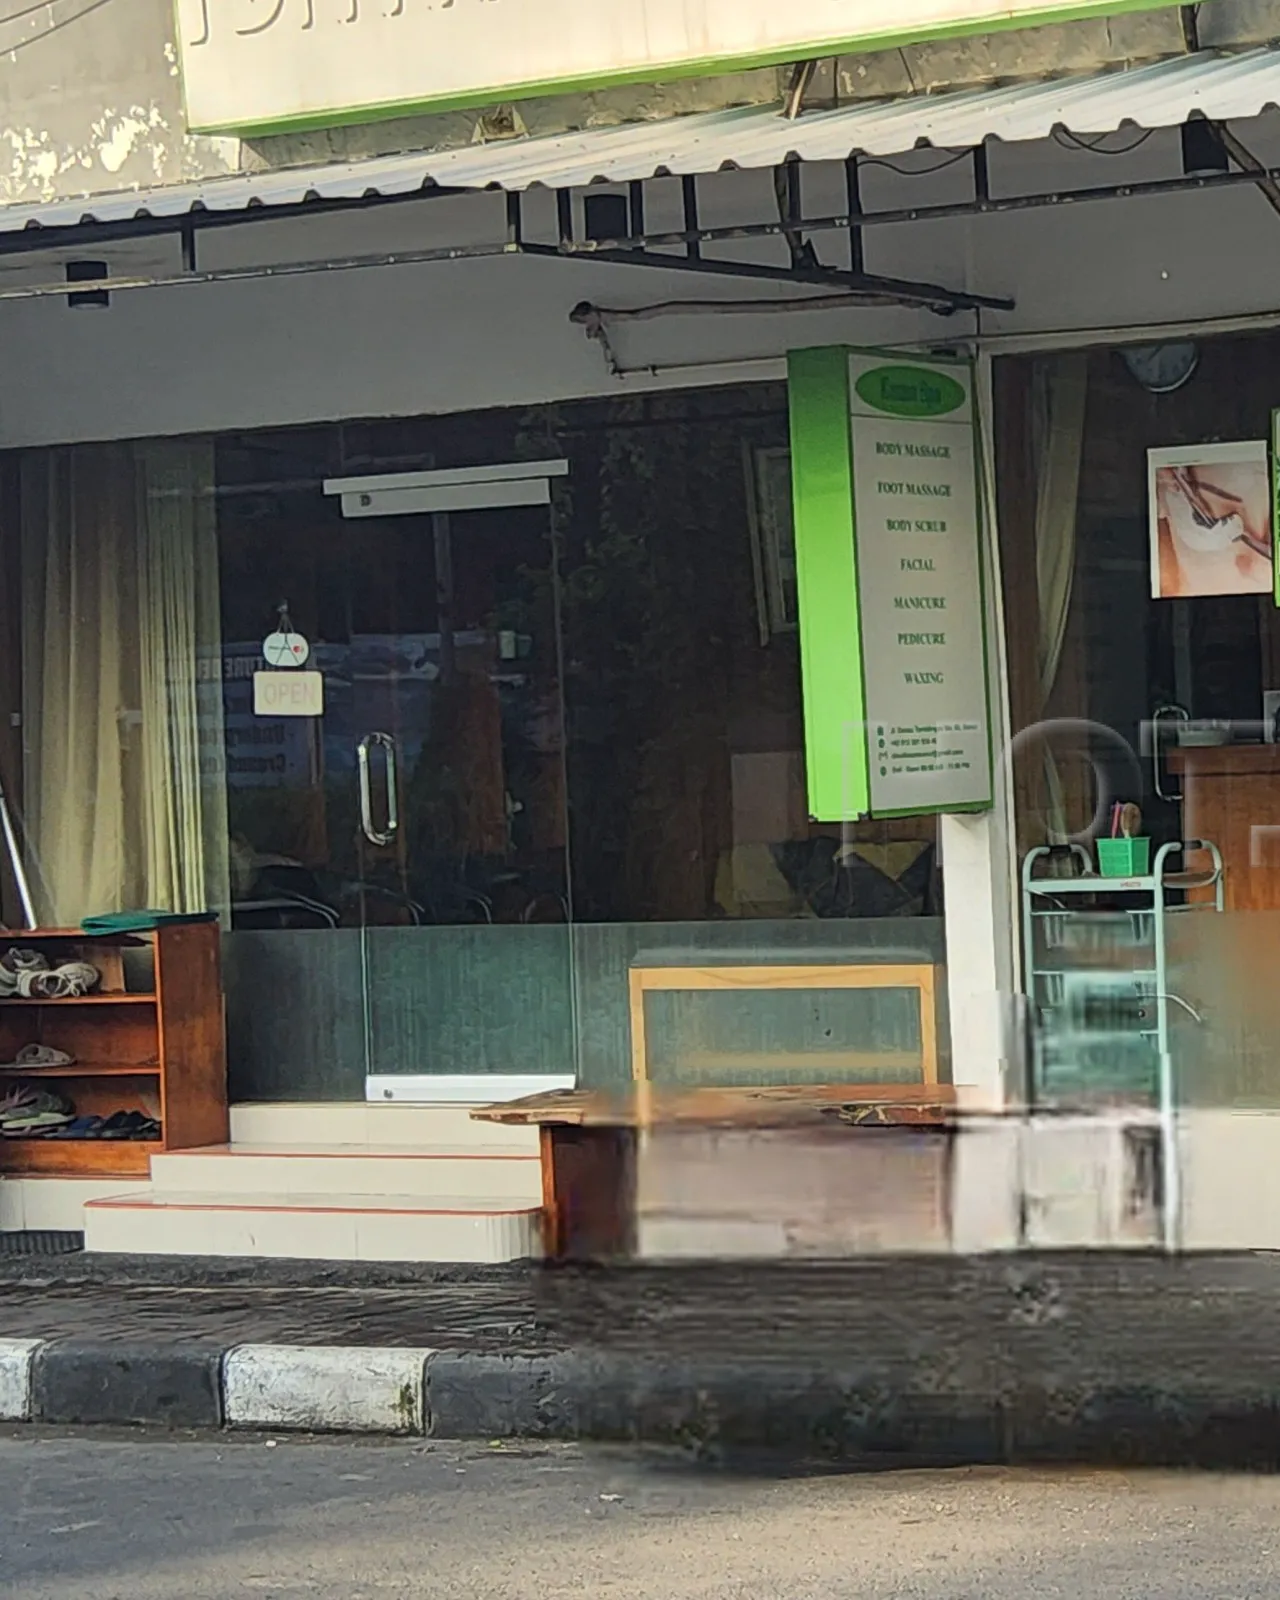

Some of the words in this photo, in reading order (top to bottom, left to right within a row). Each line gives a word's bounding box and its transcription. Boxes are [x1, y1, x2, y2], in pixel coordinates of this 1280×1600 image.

[876, 442, 902, 456] BODY
[904, 444, 951, 459] MASSAGE
[877, 481, 904, 495] FOOT
[907, 483, 952, 497] MASSAGE
[886, 519, 912, 532] BODY
[915, 520, 947, 533] SCRUB
[900, 558, 936, 572] FACIAL
[894, 597, 947, 610] MANICURE
[897, 633, 946, 645] PEDICURE
[904, 672, 944, 685] WAXING
[263, 683, 317, 707] OPEN
